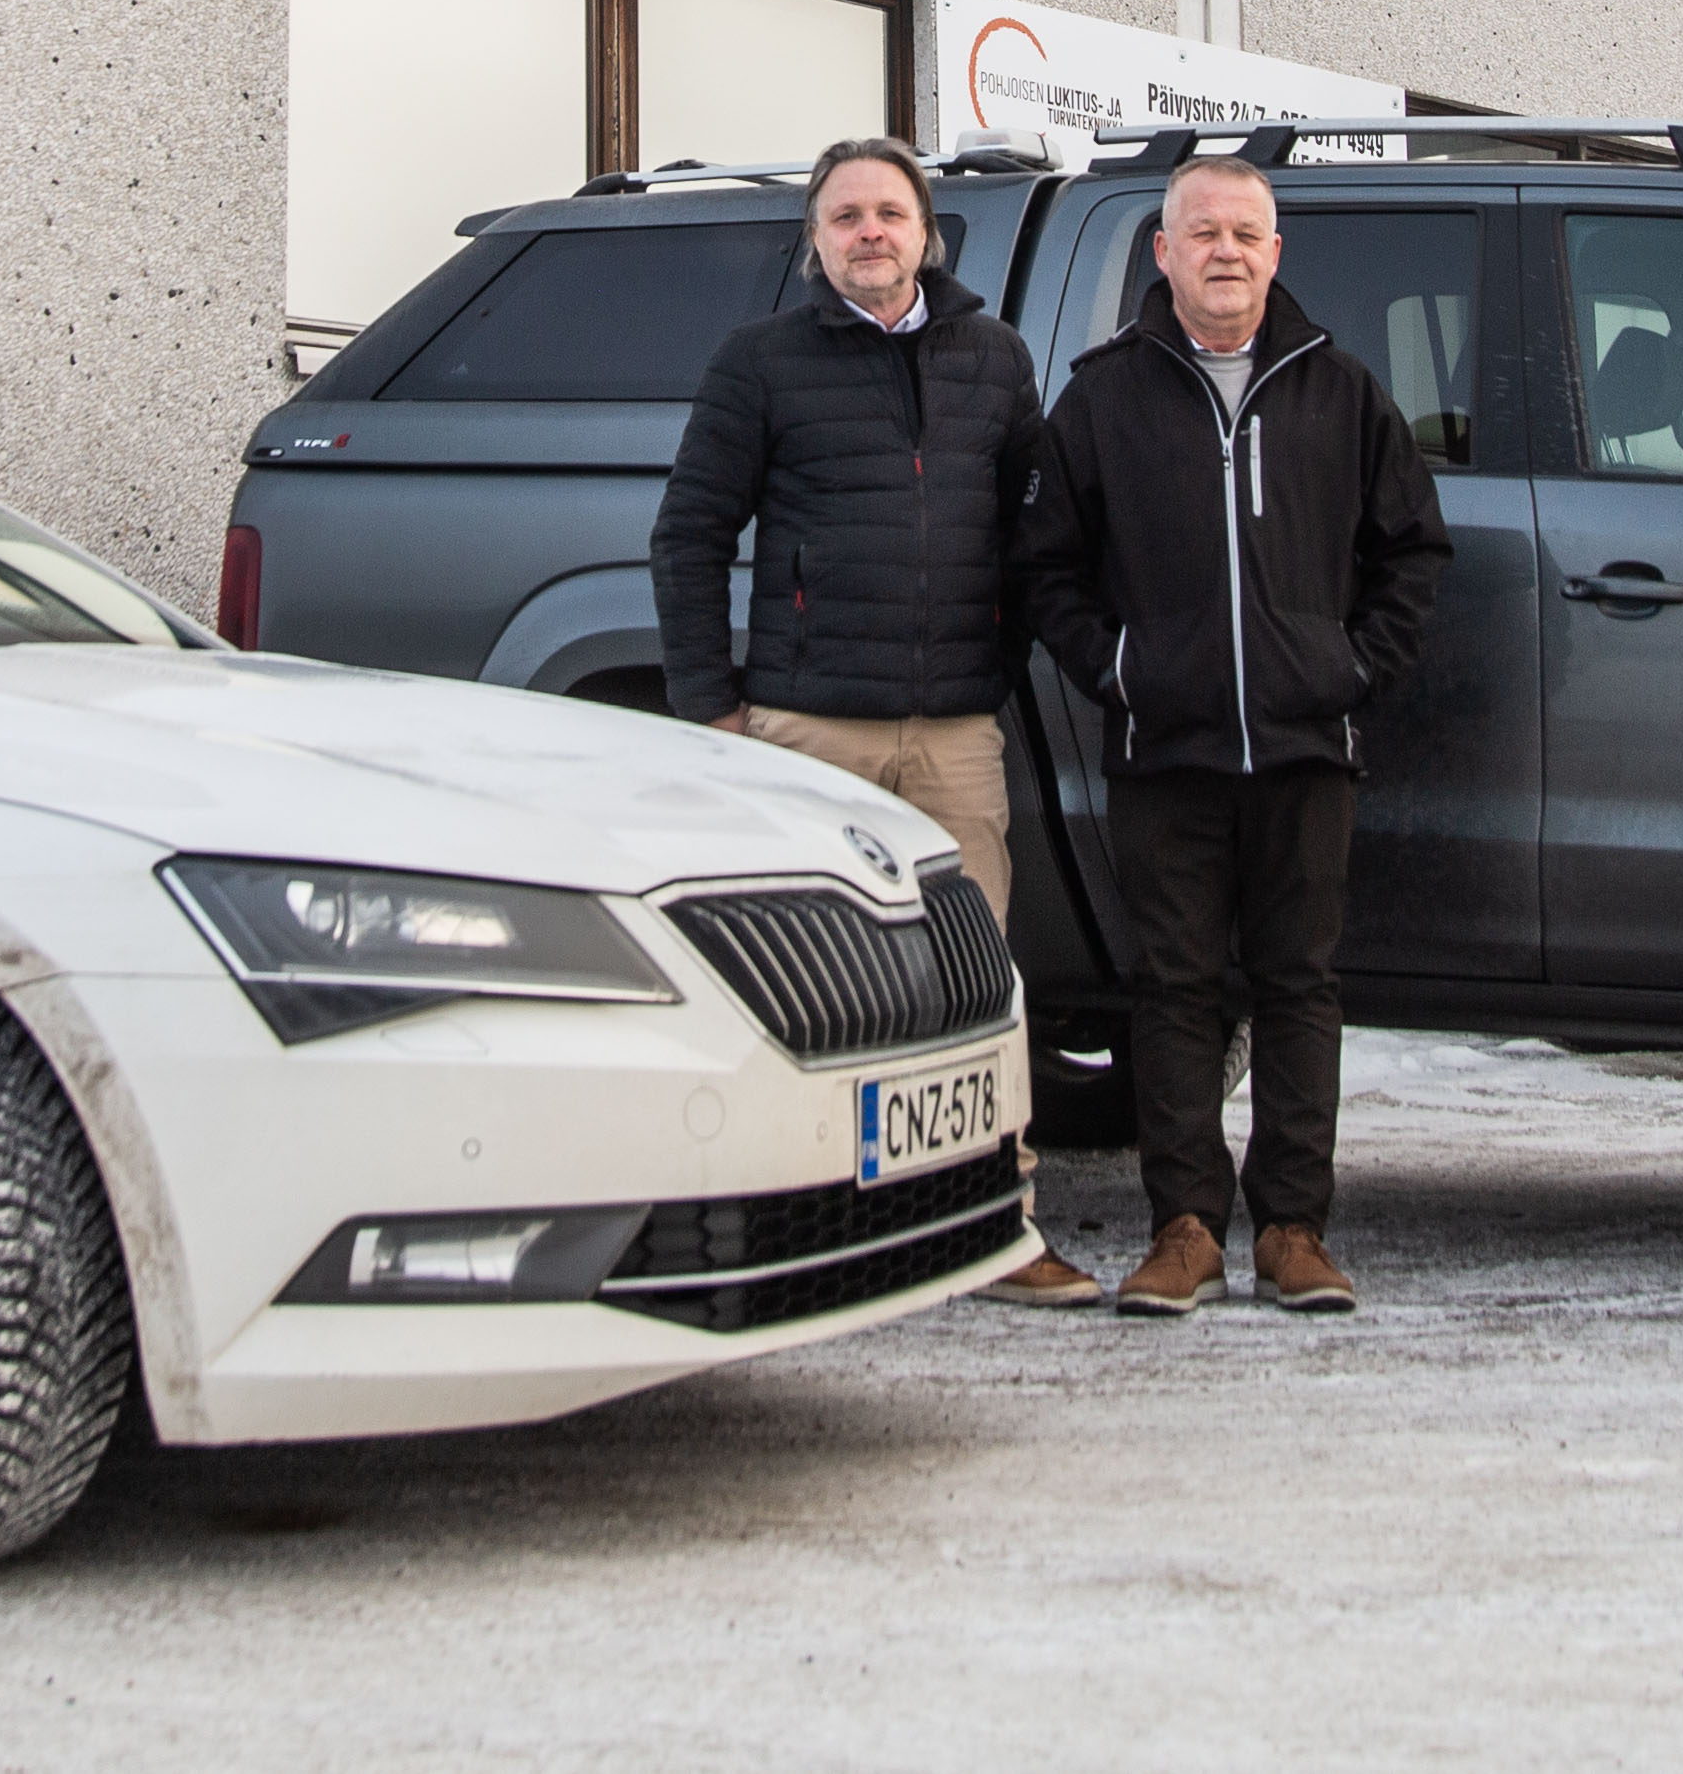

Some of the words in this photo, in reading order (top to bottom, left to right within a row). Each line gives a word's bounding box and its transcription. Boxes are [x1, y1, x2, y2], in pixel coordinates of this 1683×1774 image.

[980, 71, 1044, 103] POHJOISEN
[1047, 84, 1103, 114] LUKITUS-
[1107, 97, 1122, 119] JA
[887, 1069, 995, 1158] CNZ-578
